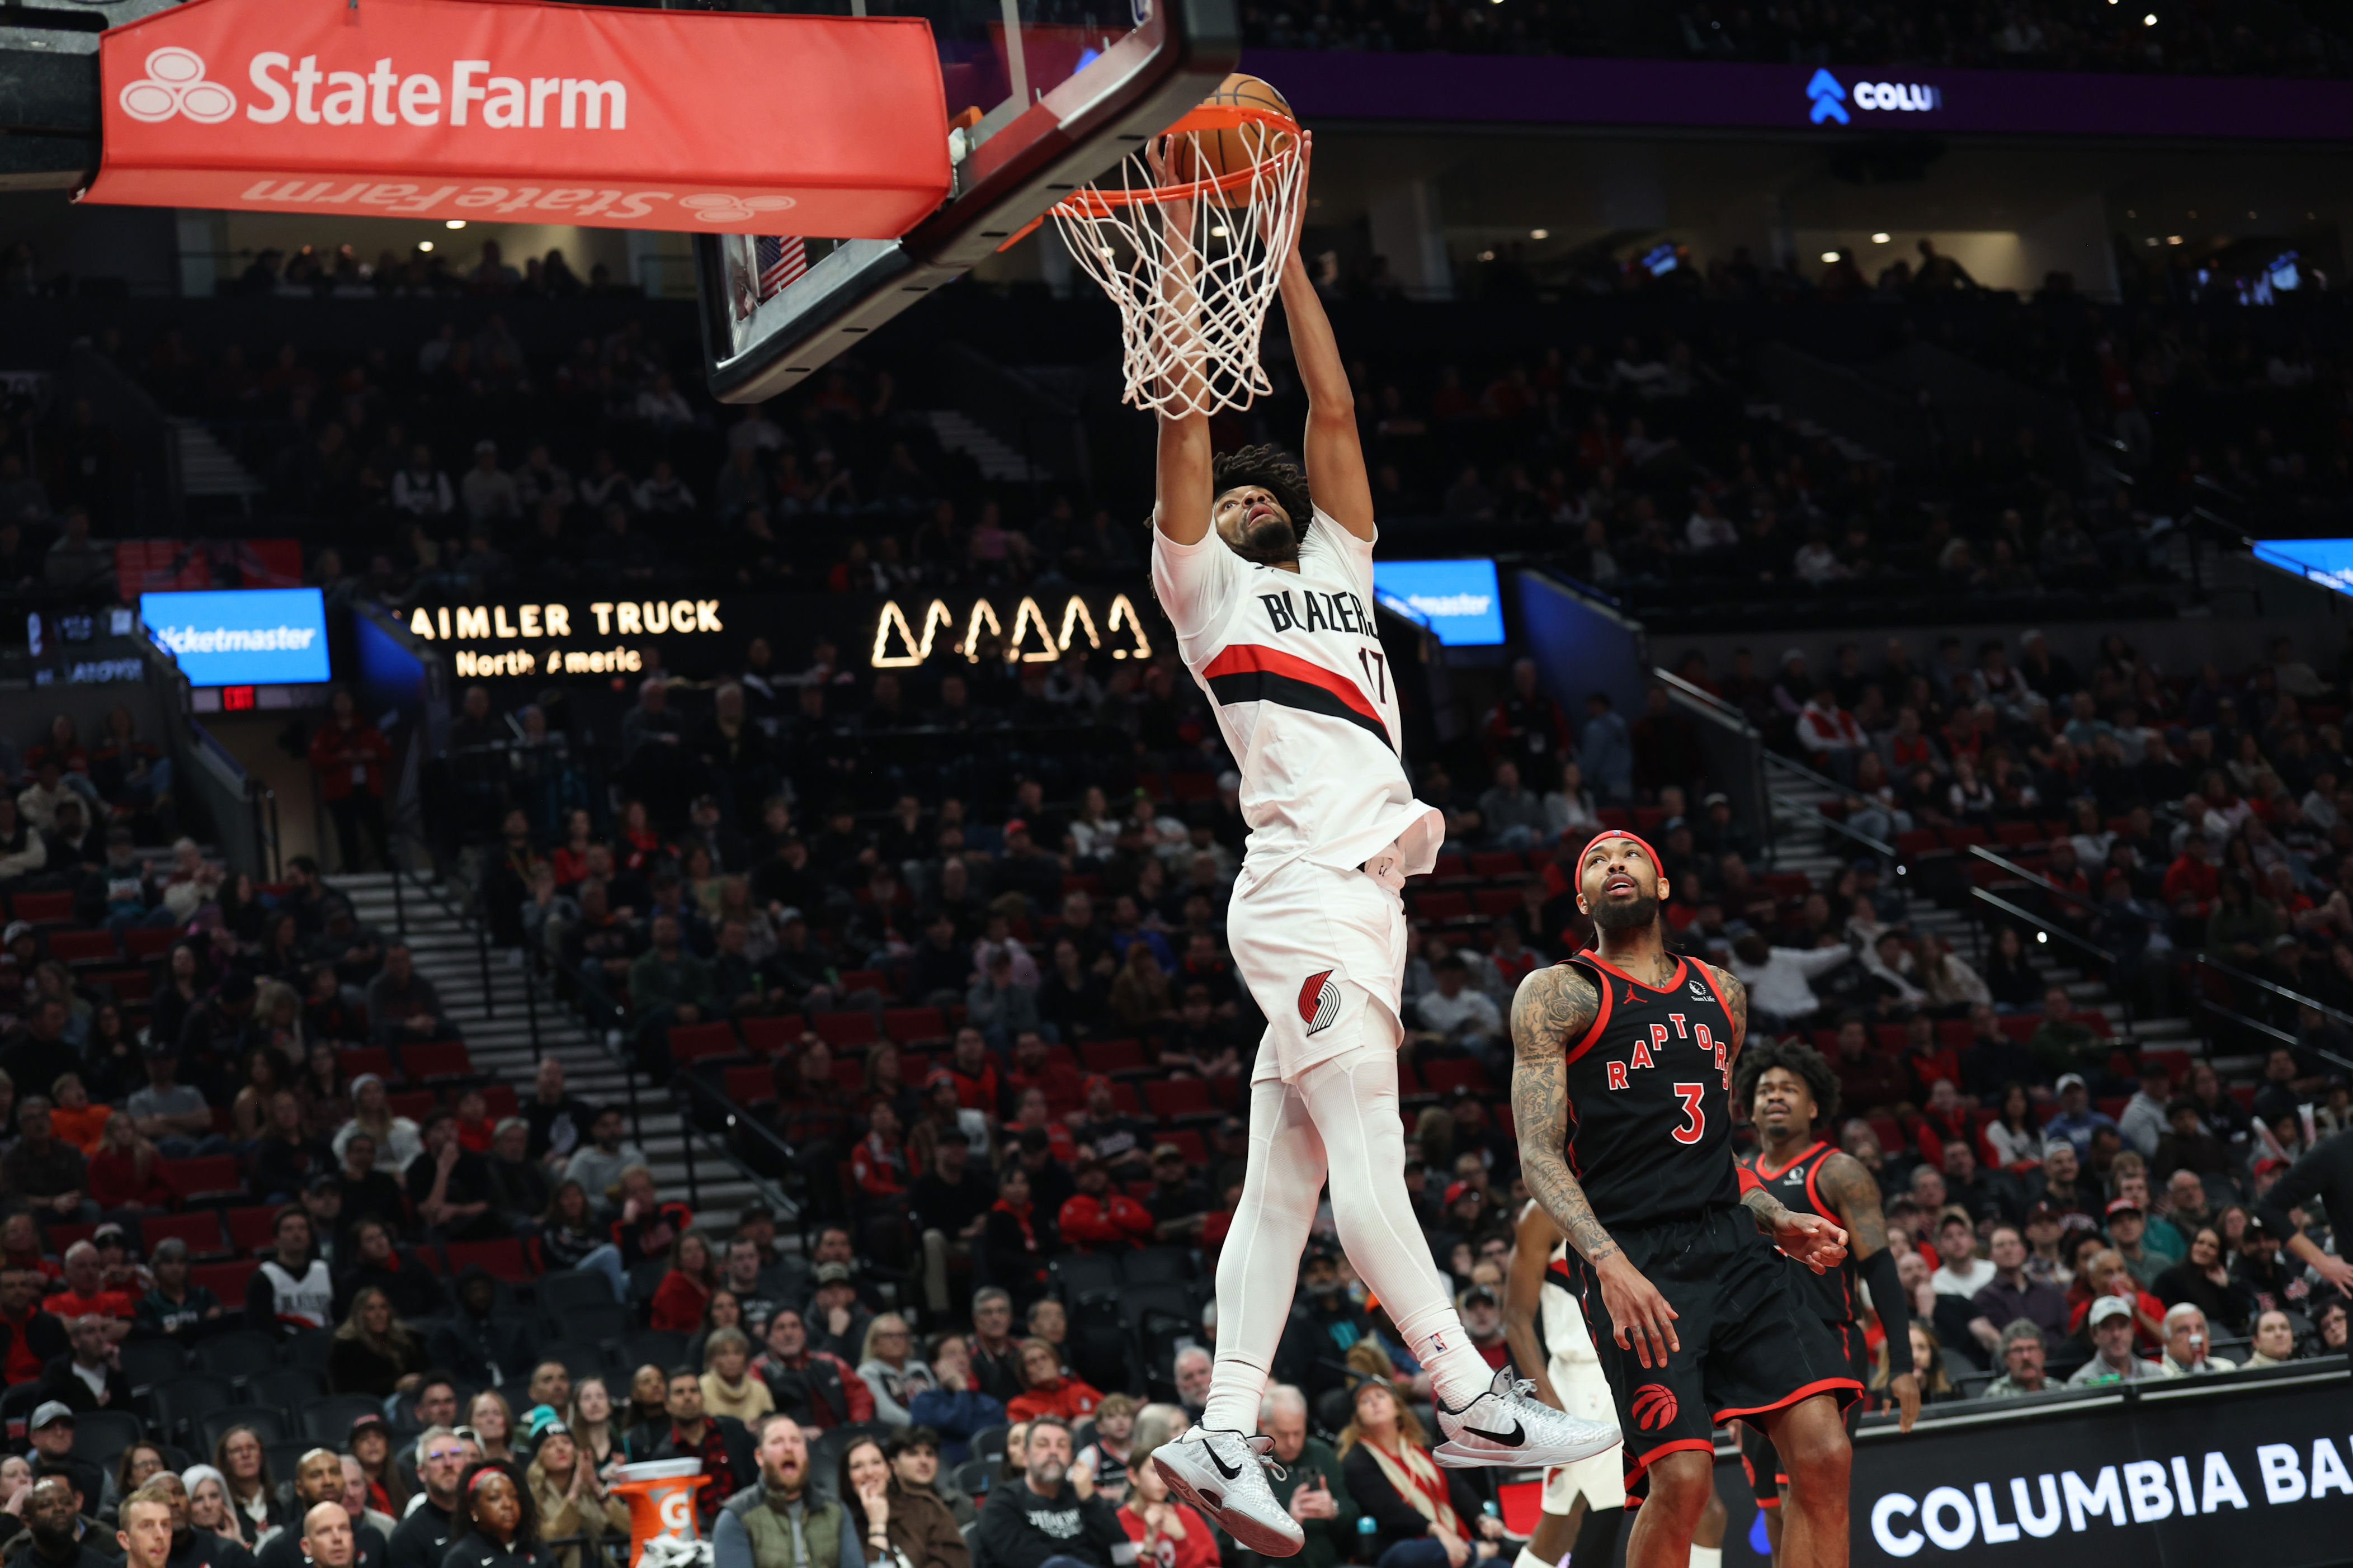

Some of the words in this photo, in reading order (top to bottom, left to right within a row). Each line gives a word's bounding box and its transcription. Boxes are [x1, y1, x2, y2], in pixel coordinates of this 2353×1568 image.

[590, 599, 723, 635] TRUCK
[455, 648, 535, 677] North
[546, 645, 643, 674] Americ
[1357, 646, 1387, 705] 17
[1671, 1082, 1705, 1144] 3
[660, 1492, 691, 1530] G
[1871, 1451, 2249, 1557] COLUMBIA
[2256, 1434, 2353, 1505] BA
